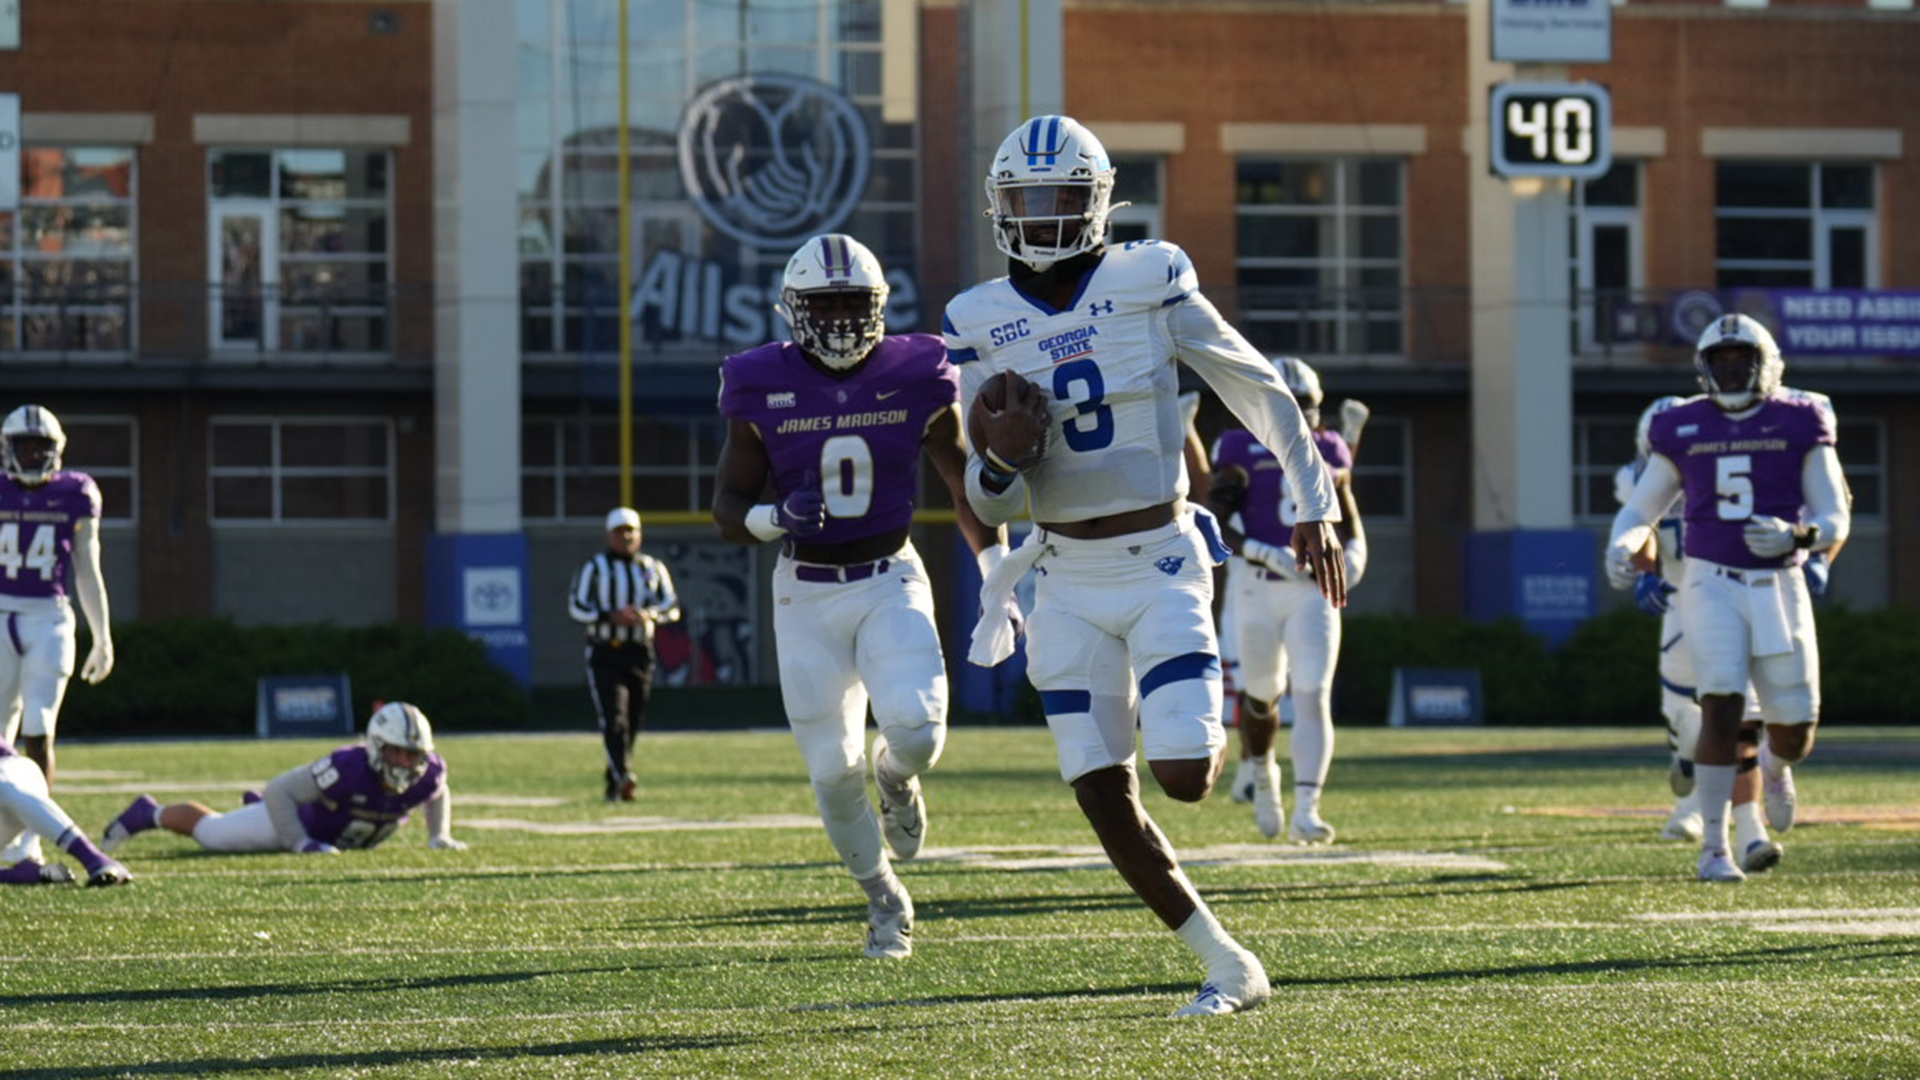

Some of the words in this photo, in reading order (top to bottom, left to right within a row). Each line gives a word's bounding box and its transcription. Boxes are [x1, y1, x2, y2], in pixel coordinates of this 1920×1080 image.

[1507, 97, 1592, 165] 40
[629, 250, 919, 343] Allse
[1783, 296, 1853, 320] NEED
[990, 318, 1030, 347] SBC
[1038, 325, 1098, 352] GEORGIA
[1786, 325, 1856, 349] YOUR
[1050, 339, 1093, 361] STATE
[1053, 358, 1114, 452] 3
[777, 416, 831, 434] JAMES
[837, 410, 908, 429] MADISON
[1687, 440, 1728, 456] JAMES
[1730, 439, 1788, 452] MADISON
[821, 435, 873, 517] 0
[1716, 454, 1754, 521] 5
[0, 523, 57, 580] 44
